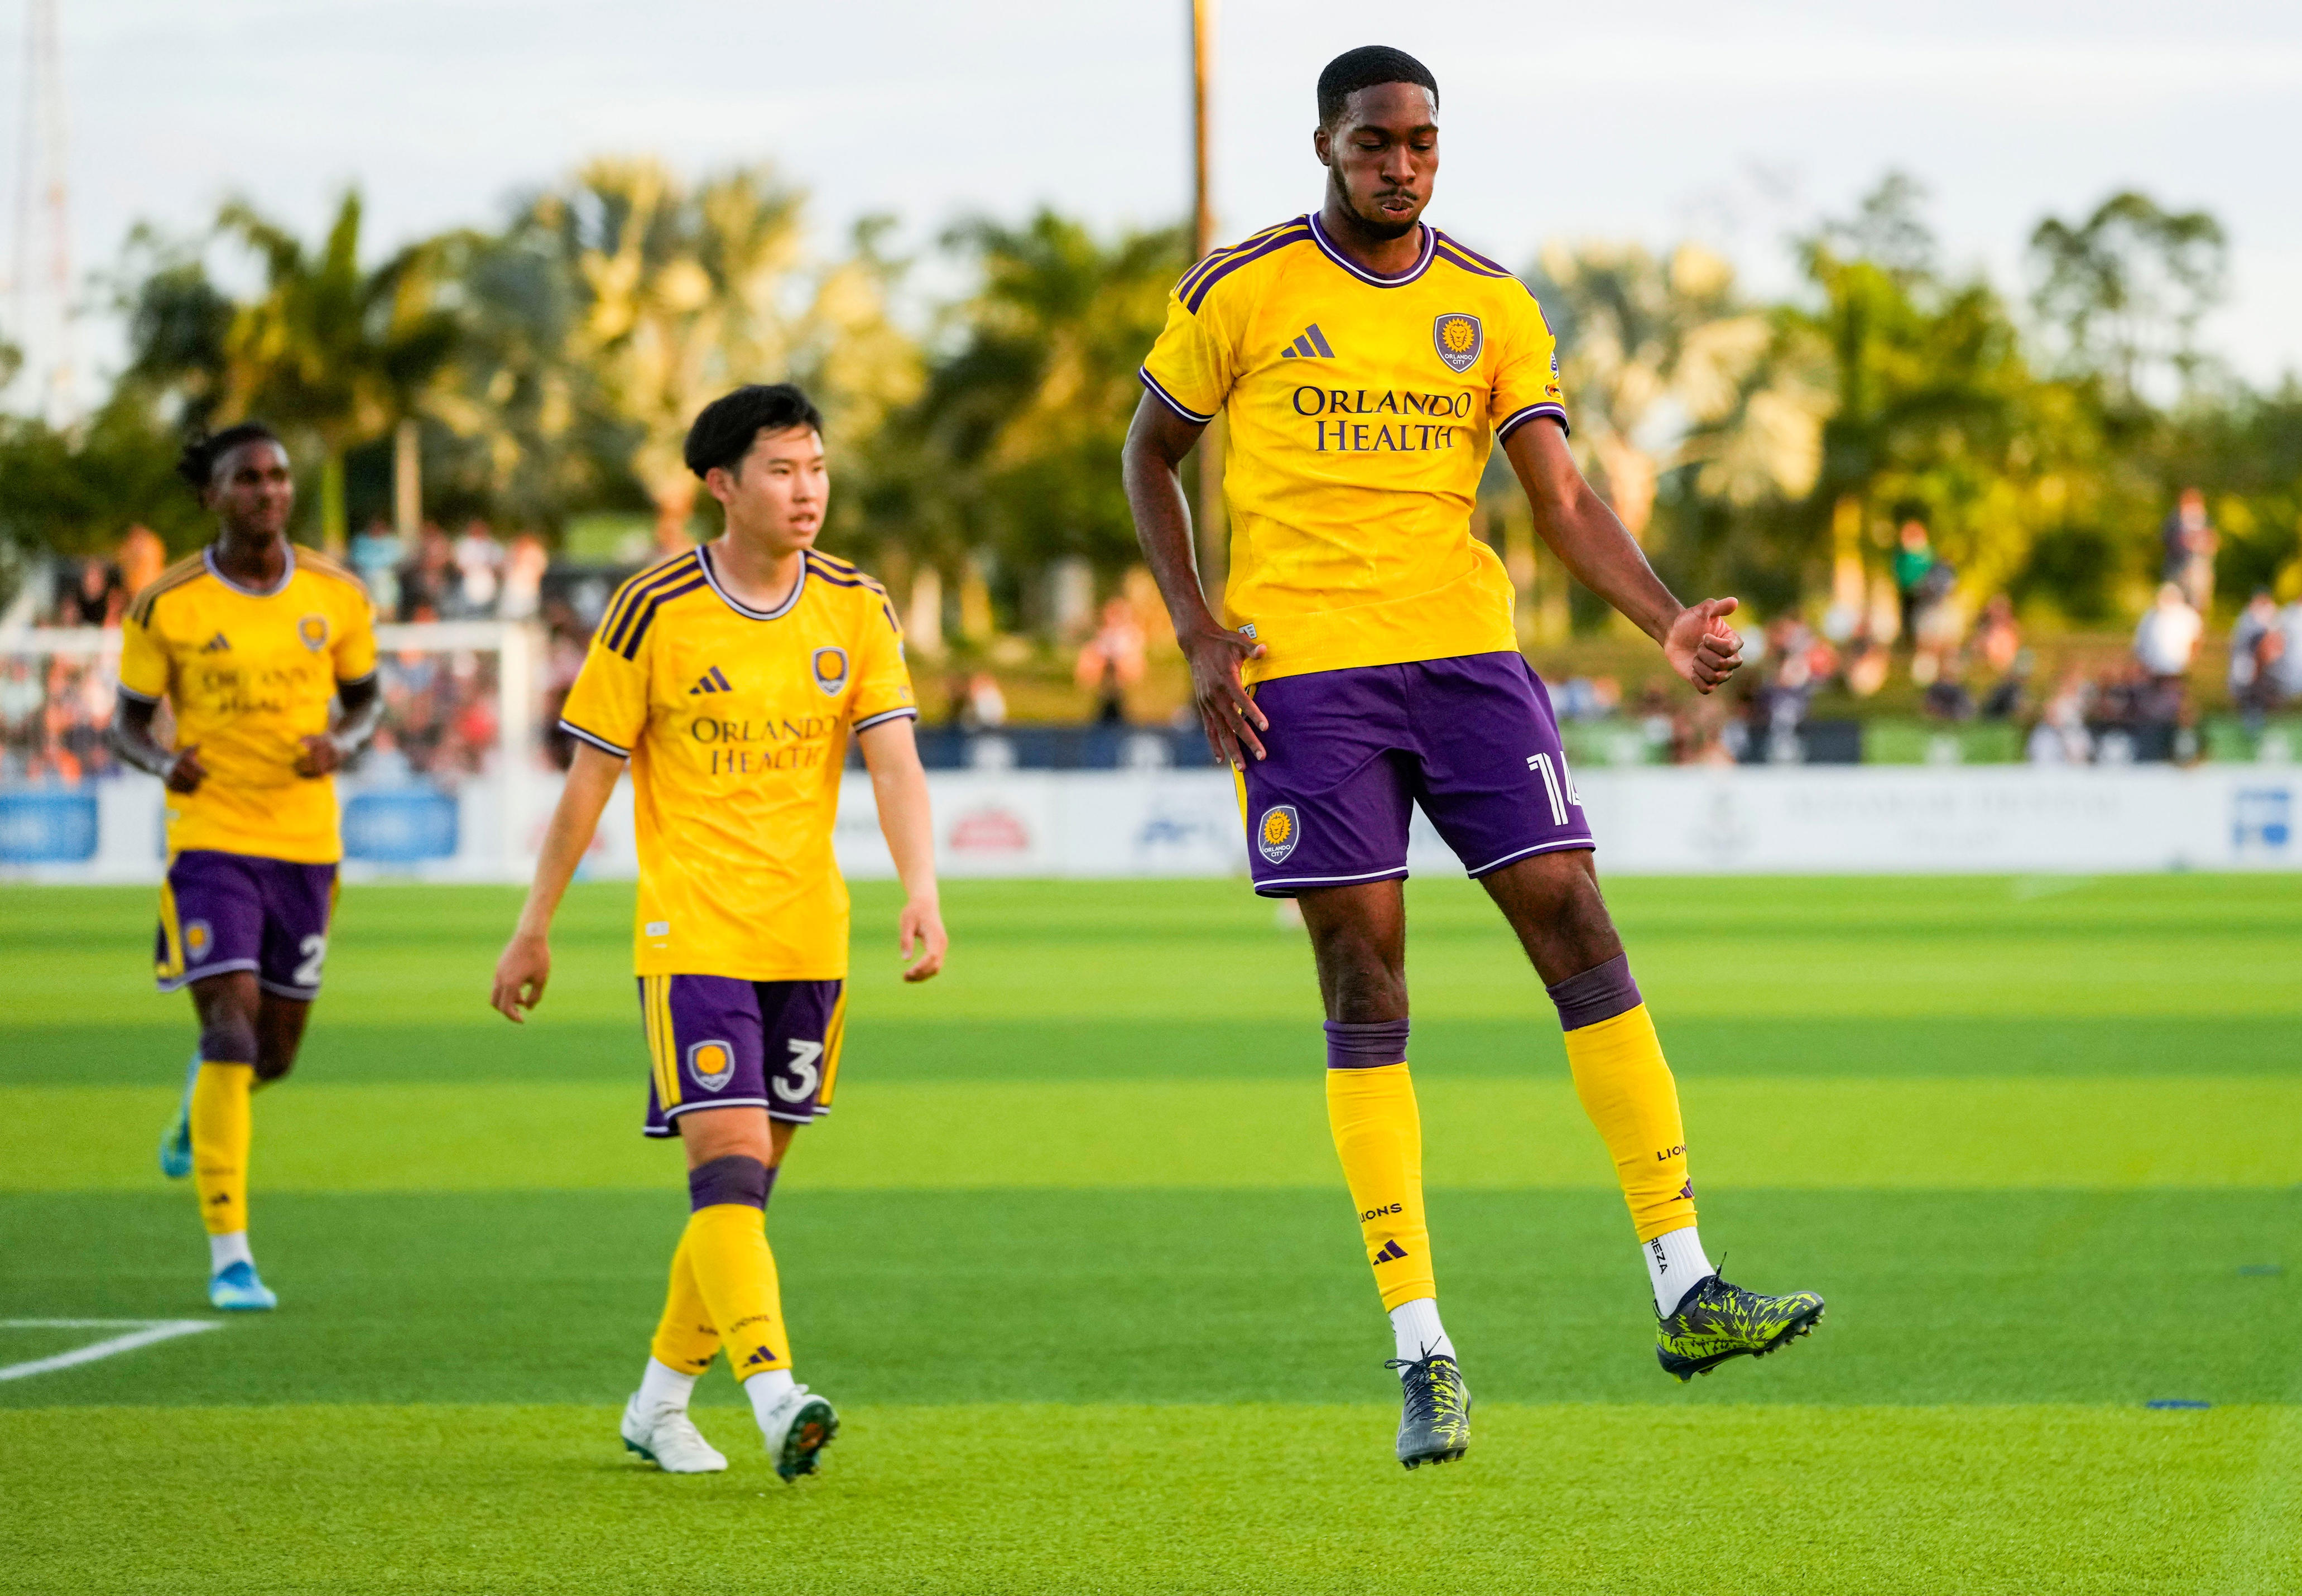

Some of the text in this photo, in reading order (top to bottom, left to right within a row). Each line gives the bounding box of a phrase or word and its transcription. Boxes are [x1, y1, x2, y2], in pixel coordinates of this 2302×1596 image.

[1292, 386, 1472, 419] ORLANDO
[1314, 420, 1454, 451] HEALTH
[1264, 844, 1291, 853] ORLANDO
[771, 1037, 823, 1104] 3
